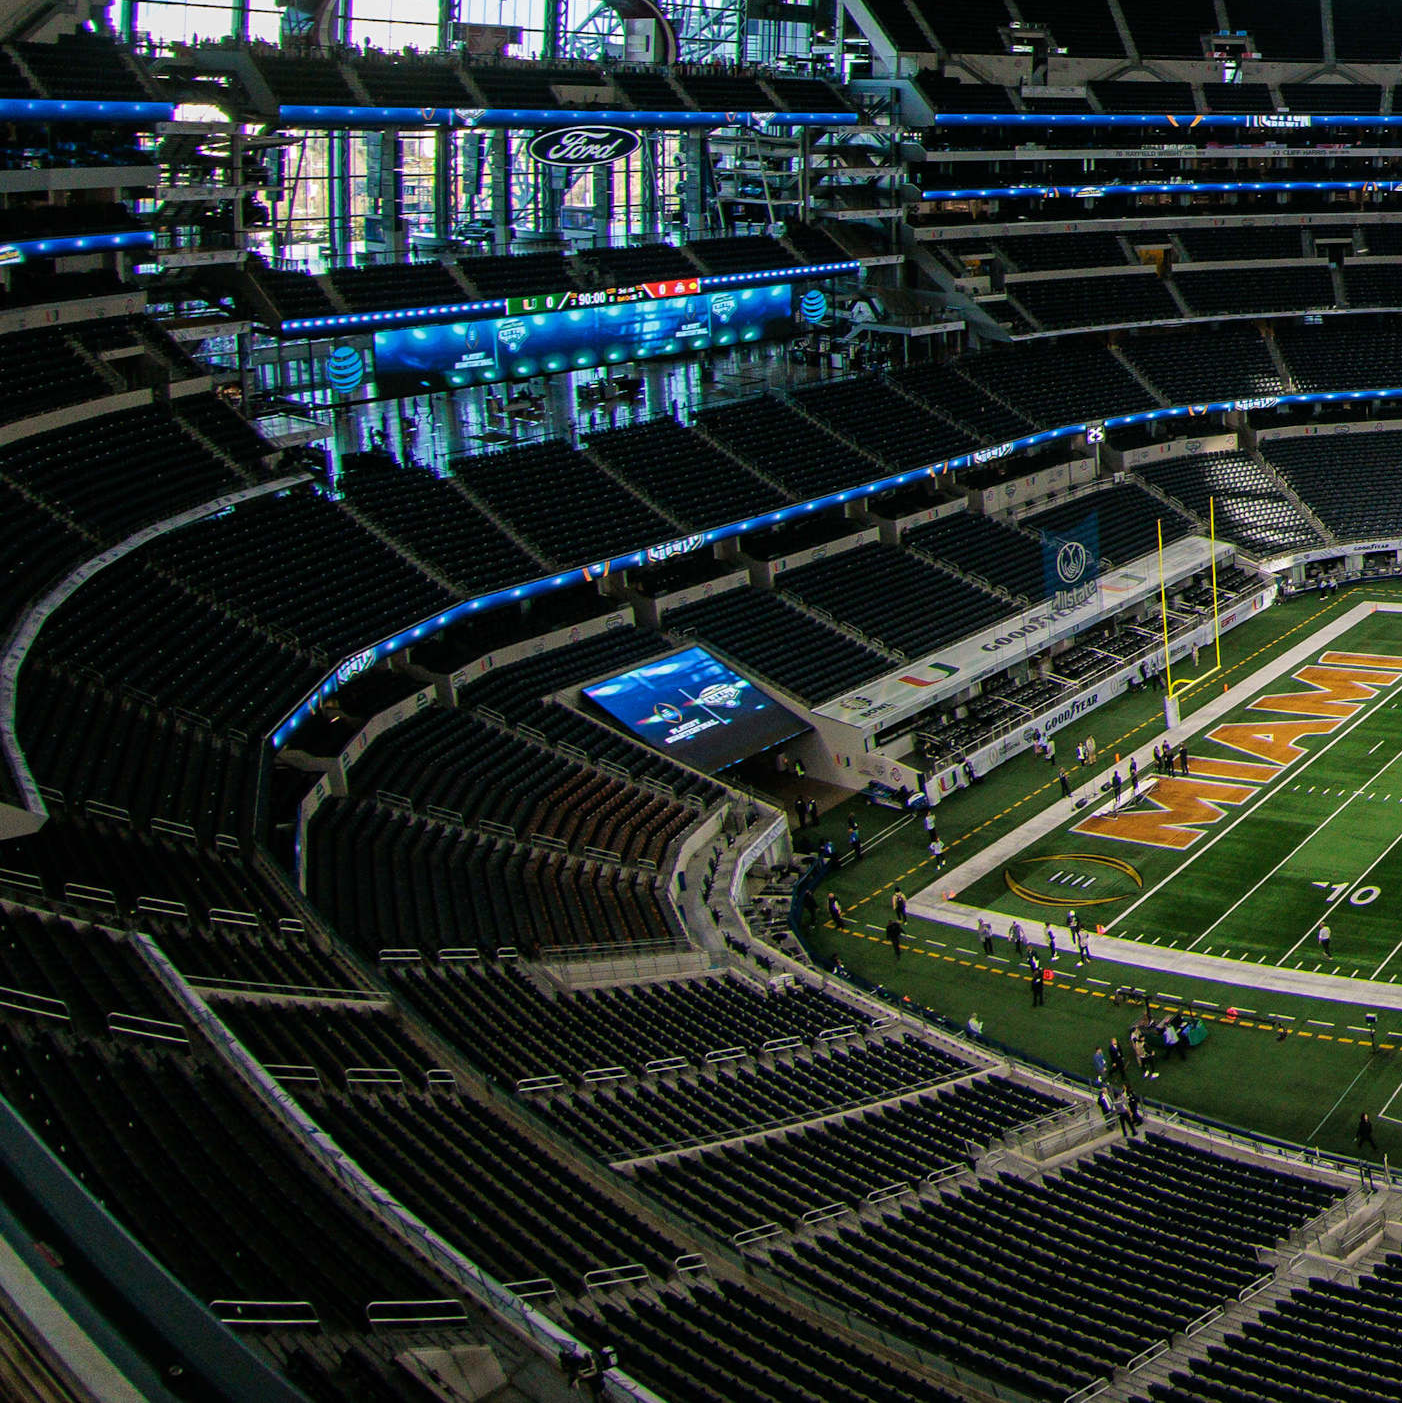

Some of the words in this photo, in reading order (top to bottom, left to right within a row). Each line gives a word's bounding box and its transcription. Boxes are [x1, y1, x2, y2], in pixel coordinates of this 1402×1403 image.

[548, 131, 624, 159] Ford
[578, 291, 606, 306] 90:00
[659, 283, 666, 295] 0
[1051, 579, 1098, 610] Allstate
[1220, 613, 1238, 628] ESPN
[1044, 693, 1099, 732] GOODYEAR
[1325, 882, 1383, 907] 10
